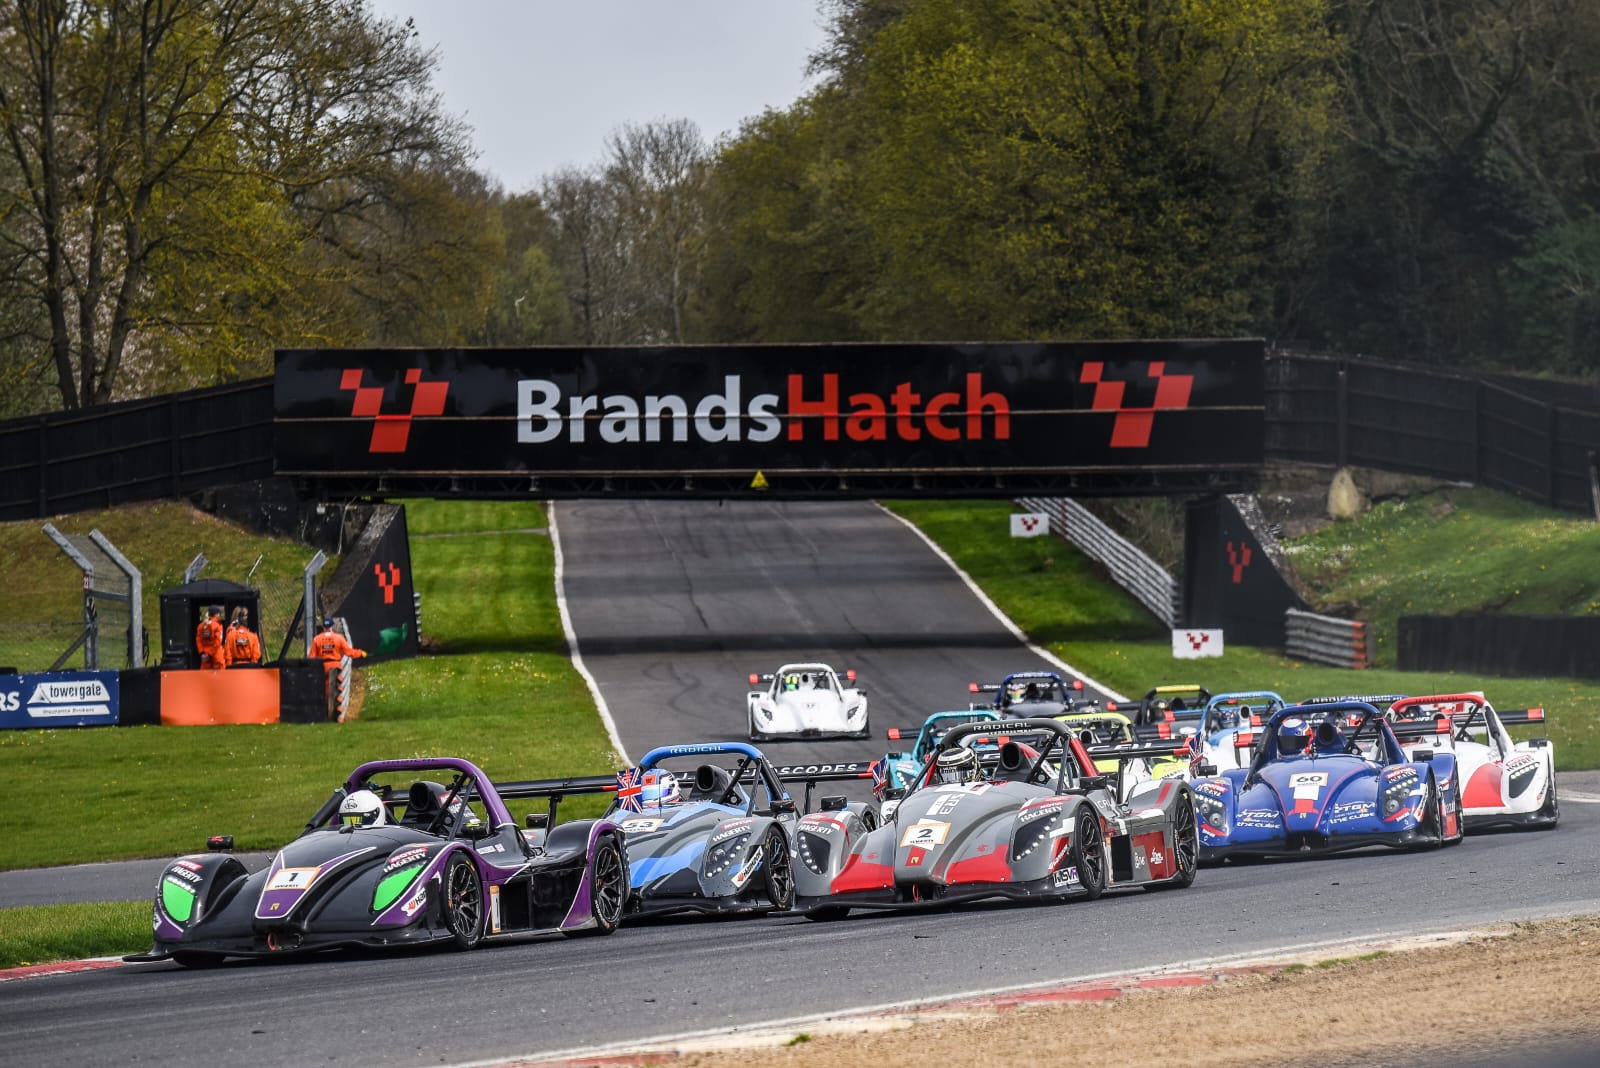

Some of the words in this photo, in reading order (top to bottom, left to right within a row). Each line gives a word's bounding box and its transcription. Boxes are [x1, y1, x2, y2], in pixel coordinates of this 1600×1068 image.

[517, 373, 1010, 443] BrandsHatch
[50, 684, 101, 699] towergate
[974, 722, 1031, 731] RADICAL
[670, 746, 725, 754] RADICAL
[1296, 775, 1322, 783] 60
[1020, 806, 1062, 822] HAGERTY
[712, 825, 751, 842] HAGERTY
[797, 824, 834, 835] HAGERTY
[917, 828, 933, 839] 2
[383, 852, 426, 872] HAGERTY
[170, 866, 203, 883] HAGERTY
[289, 872, 299, 882] 1
